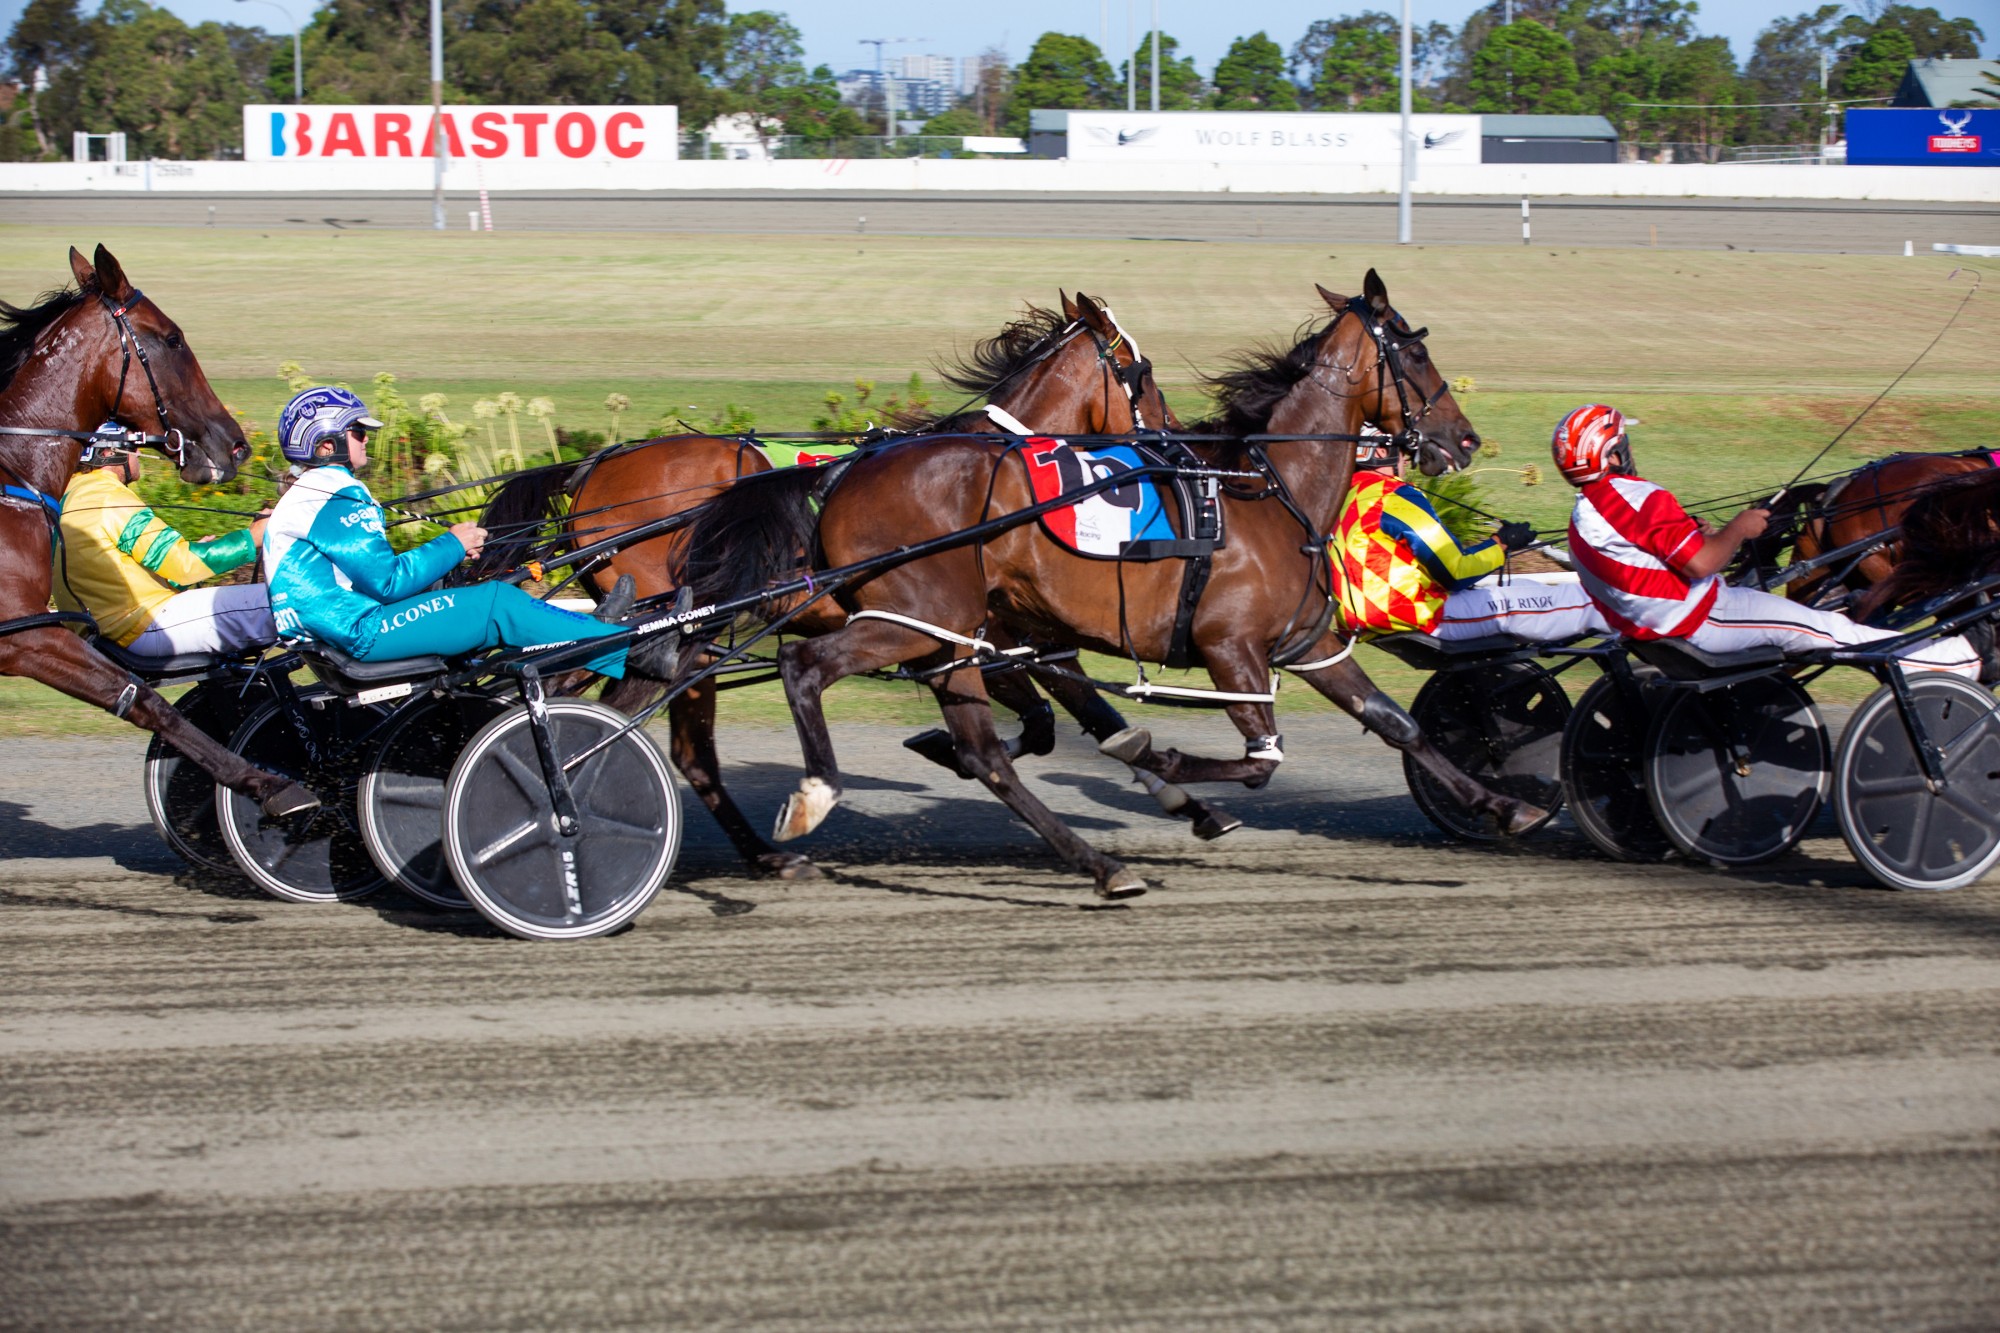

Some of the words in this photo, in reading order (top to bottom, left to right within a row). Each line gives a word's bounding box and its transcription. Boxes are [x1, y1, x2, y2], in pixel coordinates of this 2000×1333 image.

[271, 111, 645, 158] BARASTOC
[1195, 129, 1262, 146] WOLF
[1270, 130, 1348, 147] BLASS
[273, 607, 304, 633] am
[380, 593, 455, 634] J.CONEY
[637, 616, 678, 635] JEMMA
[677, 604, 716, 622] CONEY
